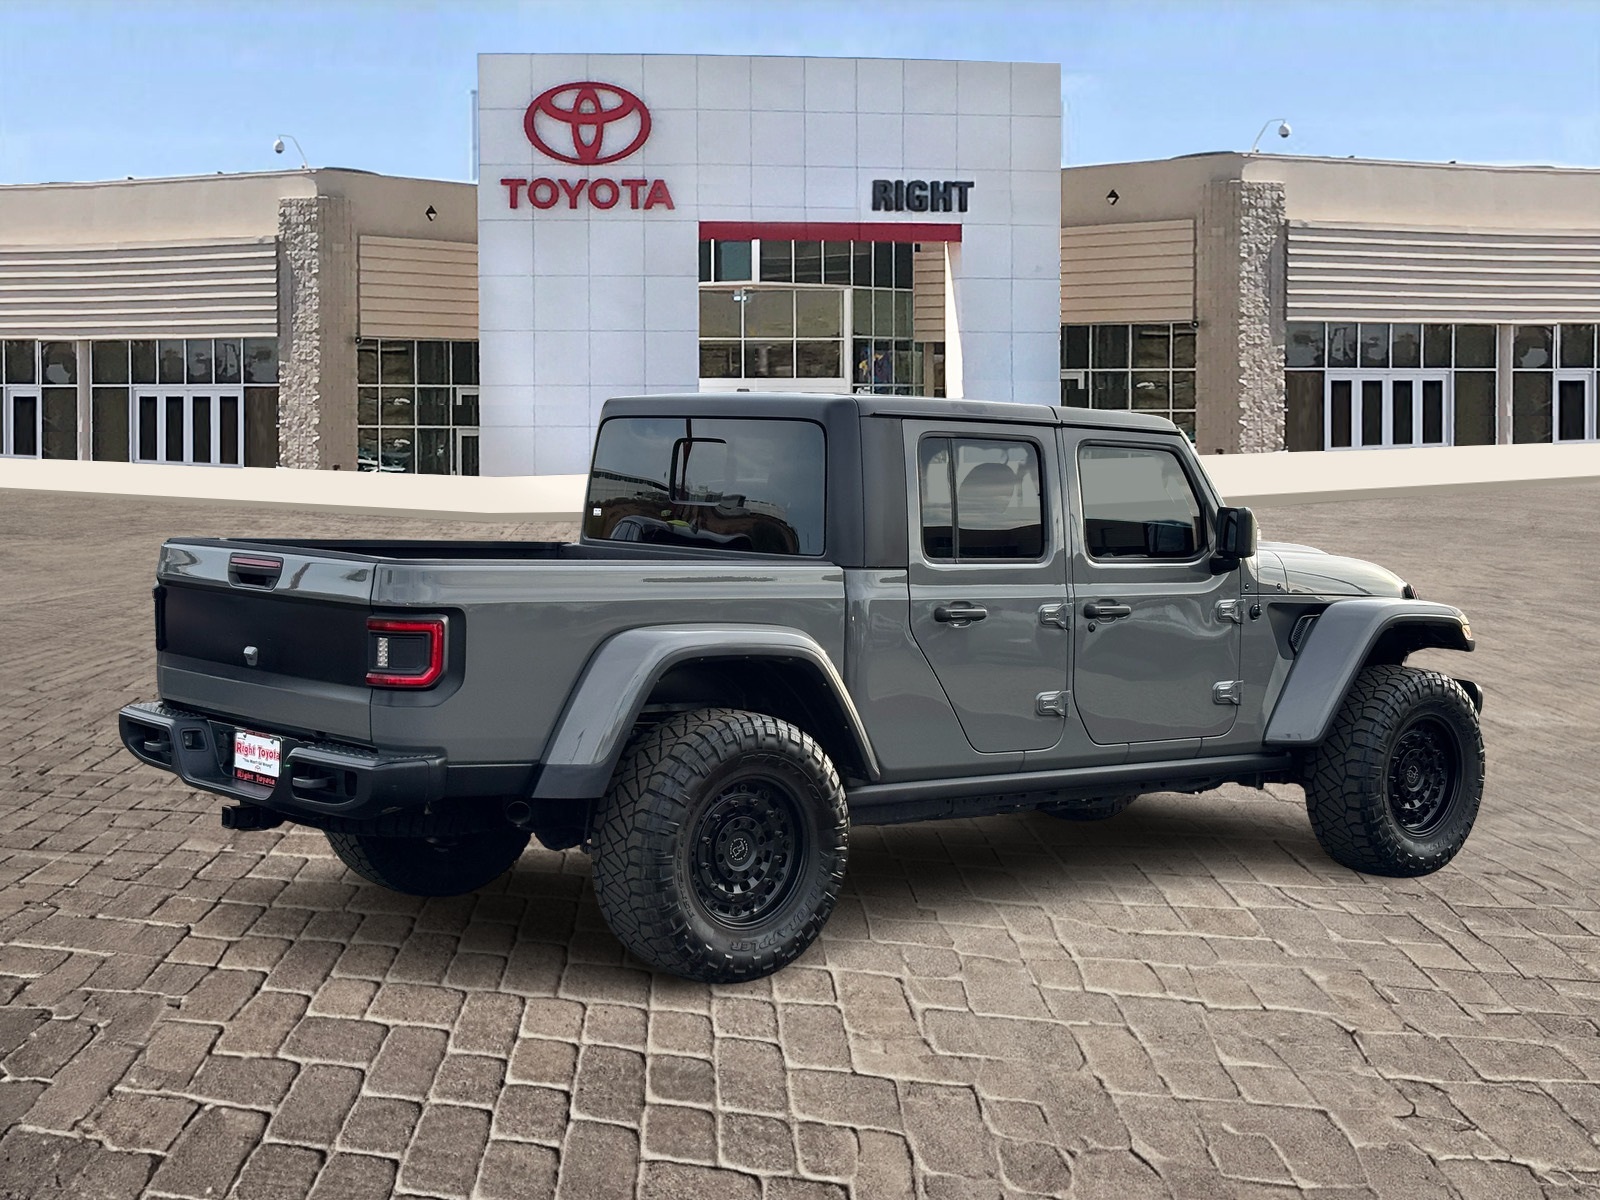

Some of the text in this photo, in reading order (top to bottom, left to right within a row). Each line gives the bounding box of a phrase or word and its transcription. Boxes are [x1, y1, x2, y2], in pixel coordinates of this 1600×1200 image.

[500, 177, 675, 209] TOYOTA
[872, 179, 975, 212] RIGHT
[236, 741, 280, 761] Right Toyota
